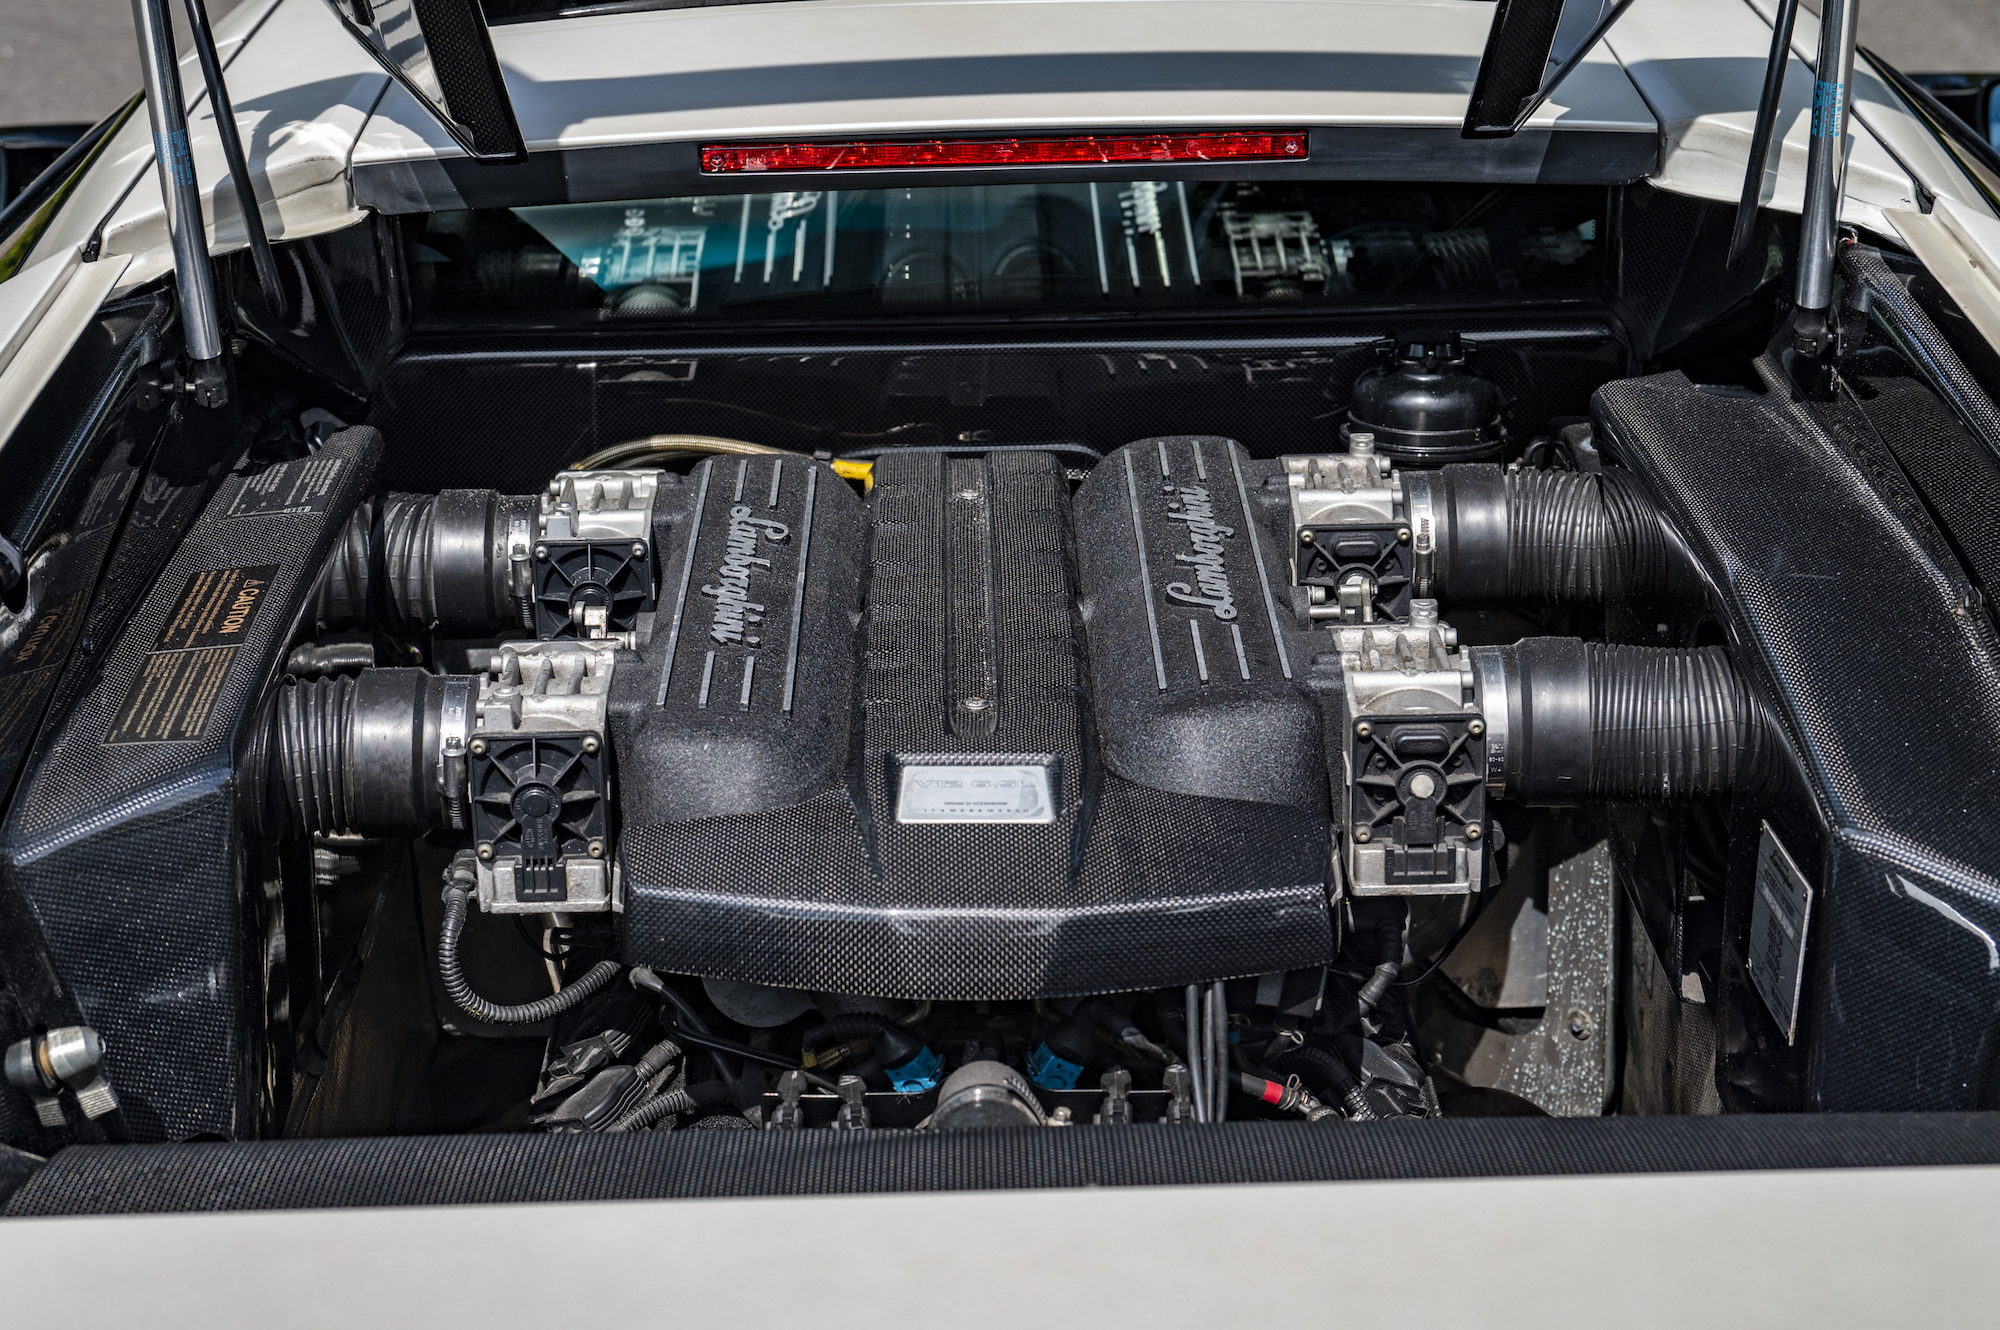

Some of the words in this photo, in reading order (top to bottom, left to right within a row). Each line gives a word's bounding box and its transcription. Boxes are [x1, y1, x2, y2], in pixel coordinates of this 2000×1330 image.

[1835, 83, 1843, 137] STABILUS
[702, 505, 789, 646] Lamborghini
[1164, 485, 1235, 620] Lamborghini
[218, 586, 261, 635] CAUTION
[915, 780, 963, 788] V12
